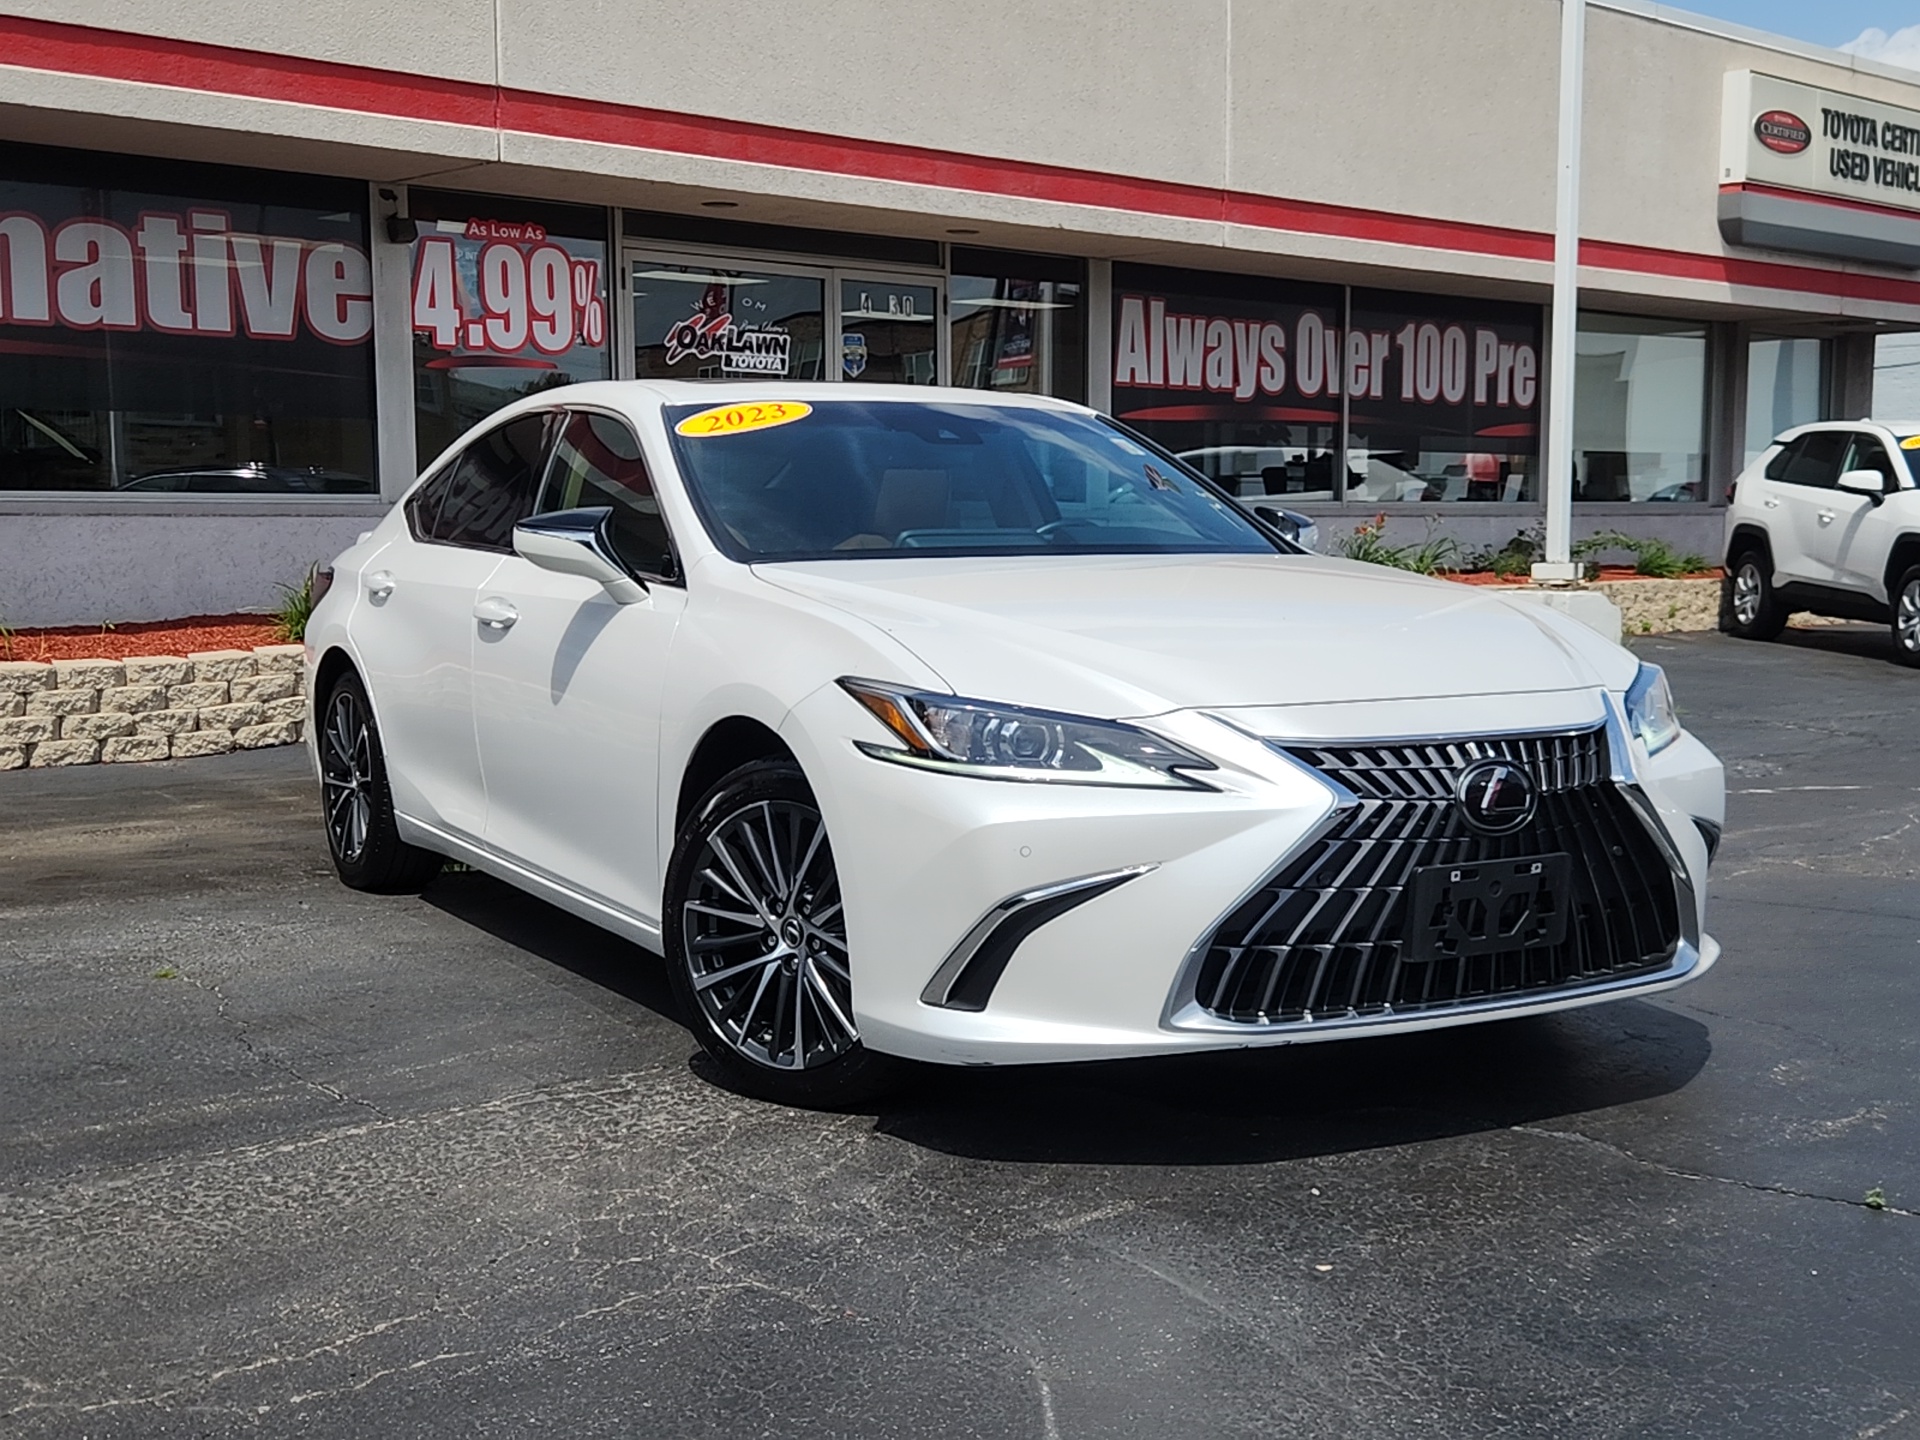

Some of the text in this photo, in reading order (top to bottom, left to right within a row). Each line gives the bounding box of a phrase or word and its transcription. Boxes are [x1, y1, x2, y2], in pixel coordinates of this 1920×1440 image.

[1760, 122, 1807, 140] CERTIFIED
[1821, 108, 1878, 148] TOYOTA
[1830, 147, 1920, 192] USED VEHICL
[468, 222, 543, 240] As Low As
[413, 239, 603, 351] 4.99%
[730, 355, 782, 370] TOYOTA
[1115, 297, 1537, 407] Always Over 100 Pre
[703, 403, 787, 433] 2023
